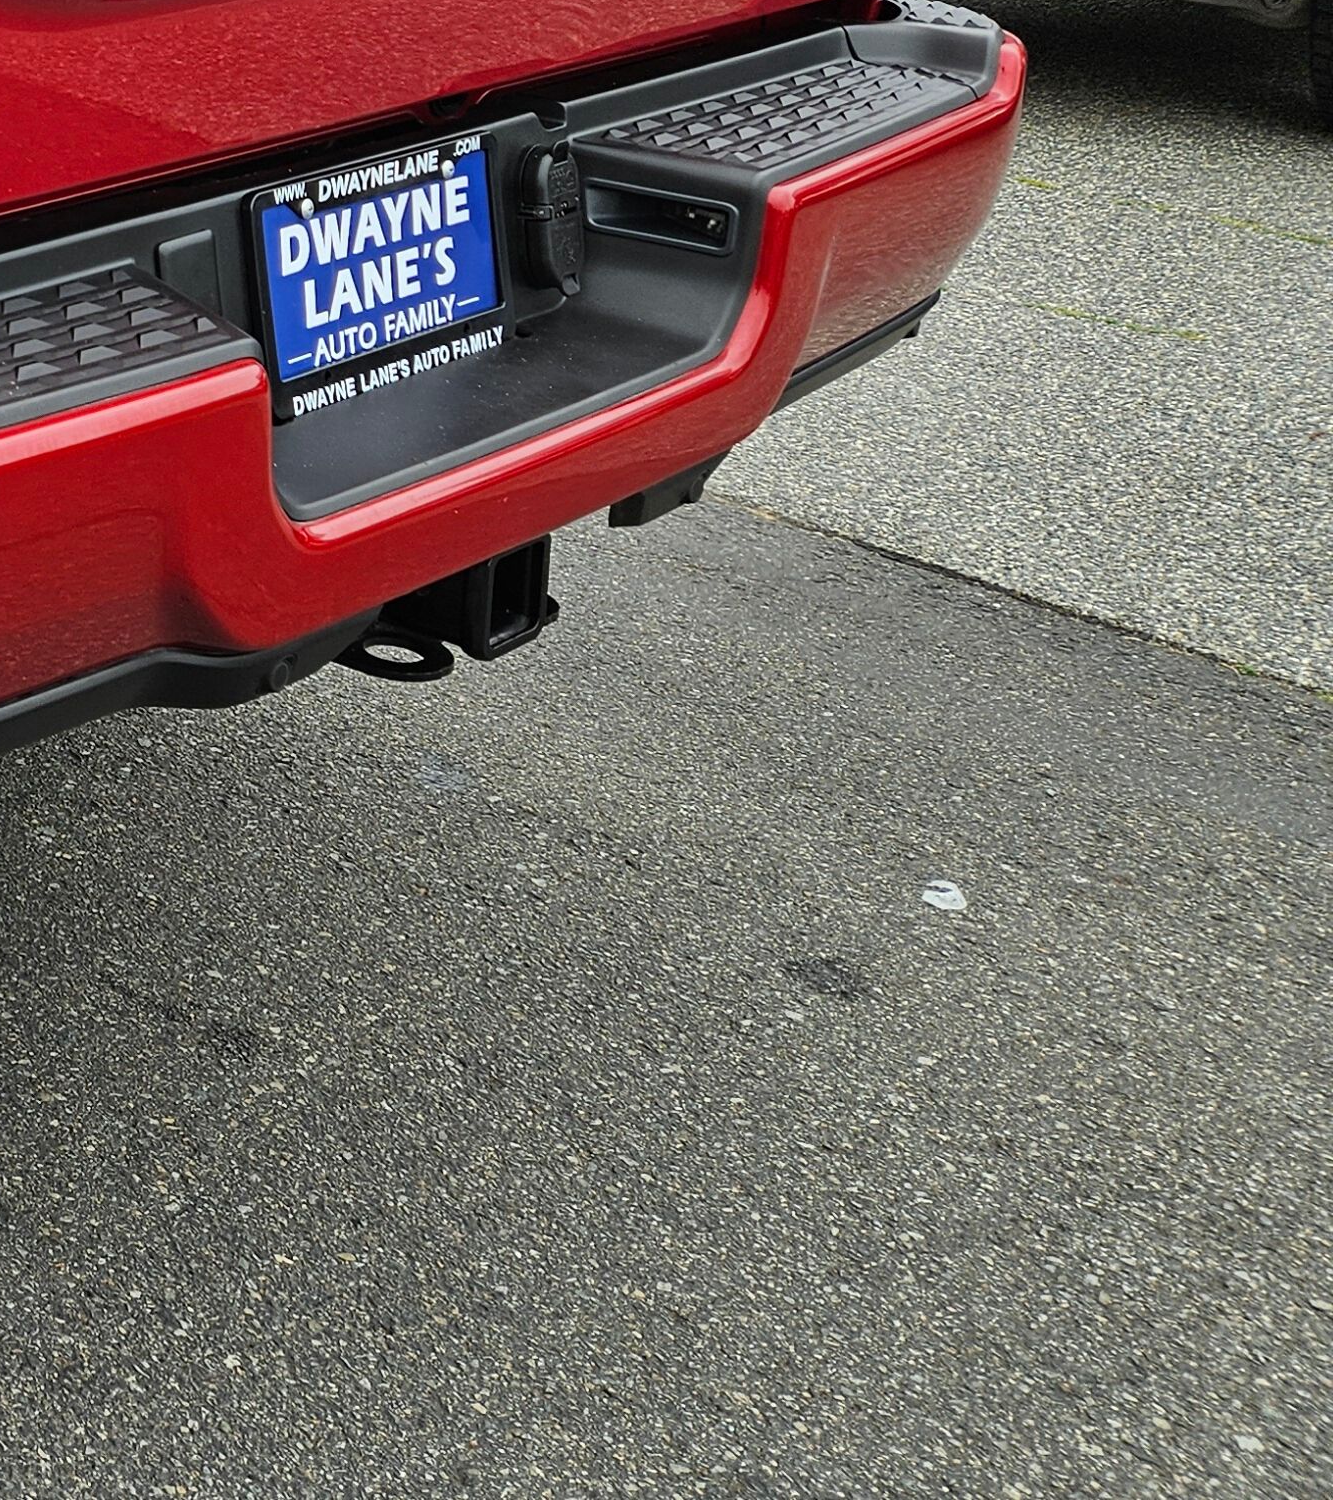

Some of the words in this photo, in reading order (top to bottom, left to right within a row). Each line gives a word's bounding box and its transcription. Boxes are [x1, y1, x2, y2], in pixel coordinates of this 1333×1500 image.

[318, 150, 439, 203] DWAYNELANE
[279, 175, 471, 276] DWAYNE
[303, 236, 457, 329] LANE'S
[292, 376, 358, 417] DWAYNE
[359, 358, 411, 393] LANE'S
[413, 344, 451, 375] AUTO
[452, 325, 505, 359] FAMILY
[313, 323, 378, 367] AUTO
[384, 293, 457, 340] FAMILY
